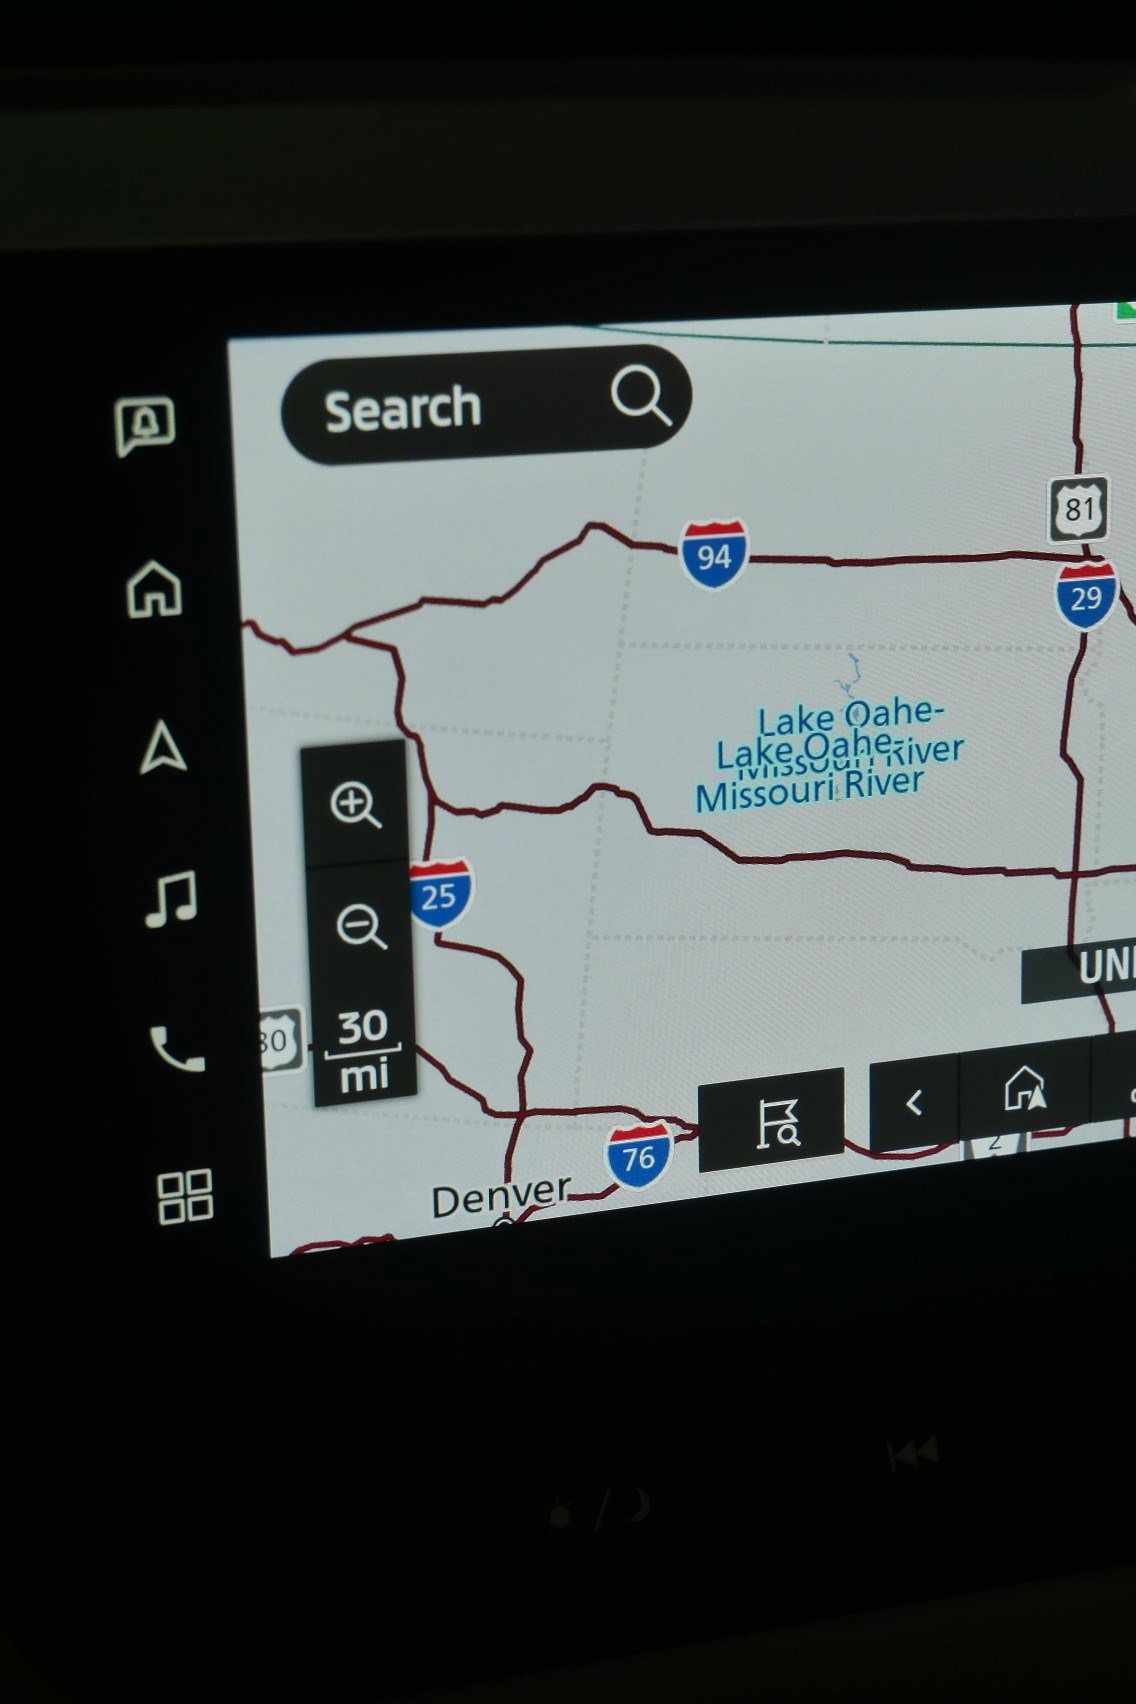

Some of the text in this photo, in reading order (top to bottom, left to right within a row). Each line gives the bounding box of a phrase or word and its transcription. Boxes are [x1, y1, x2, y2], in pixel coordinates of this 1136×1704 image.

[324, 383, 482, 434] Search
[1065, 497, 1094, 521] 81
[697, 543, 733, 570] 94
[1071, 586, 1103, 611] 29
[758, 696, 945, 737] Lake Oahe-
[717, 736, 793, 769] Lake
[696, 770, 925, 813] Missouri River
[421, 883, 457, 911] 25
[338, 1008, 388, 1045] 30
[341, 1056, 389, 1094] mi
[622, 1146, 656, 1173] 76
[432, 1176, 573, 1220] Denver
